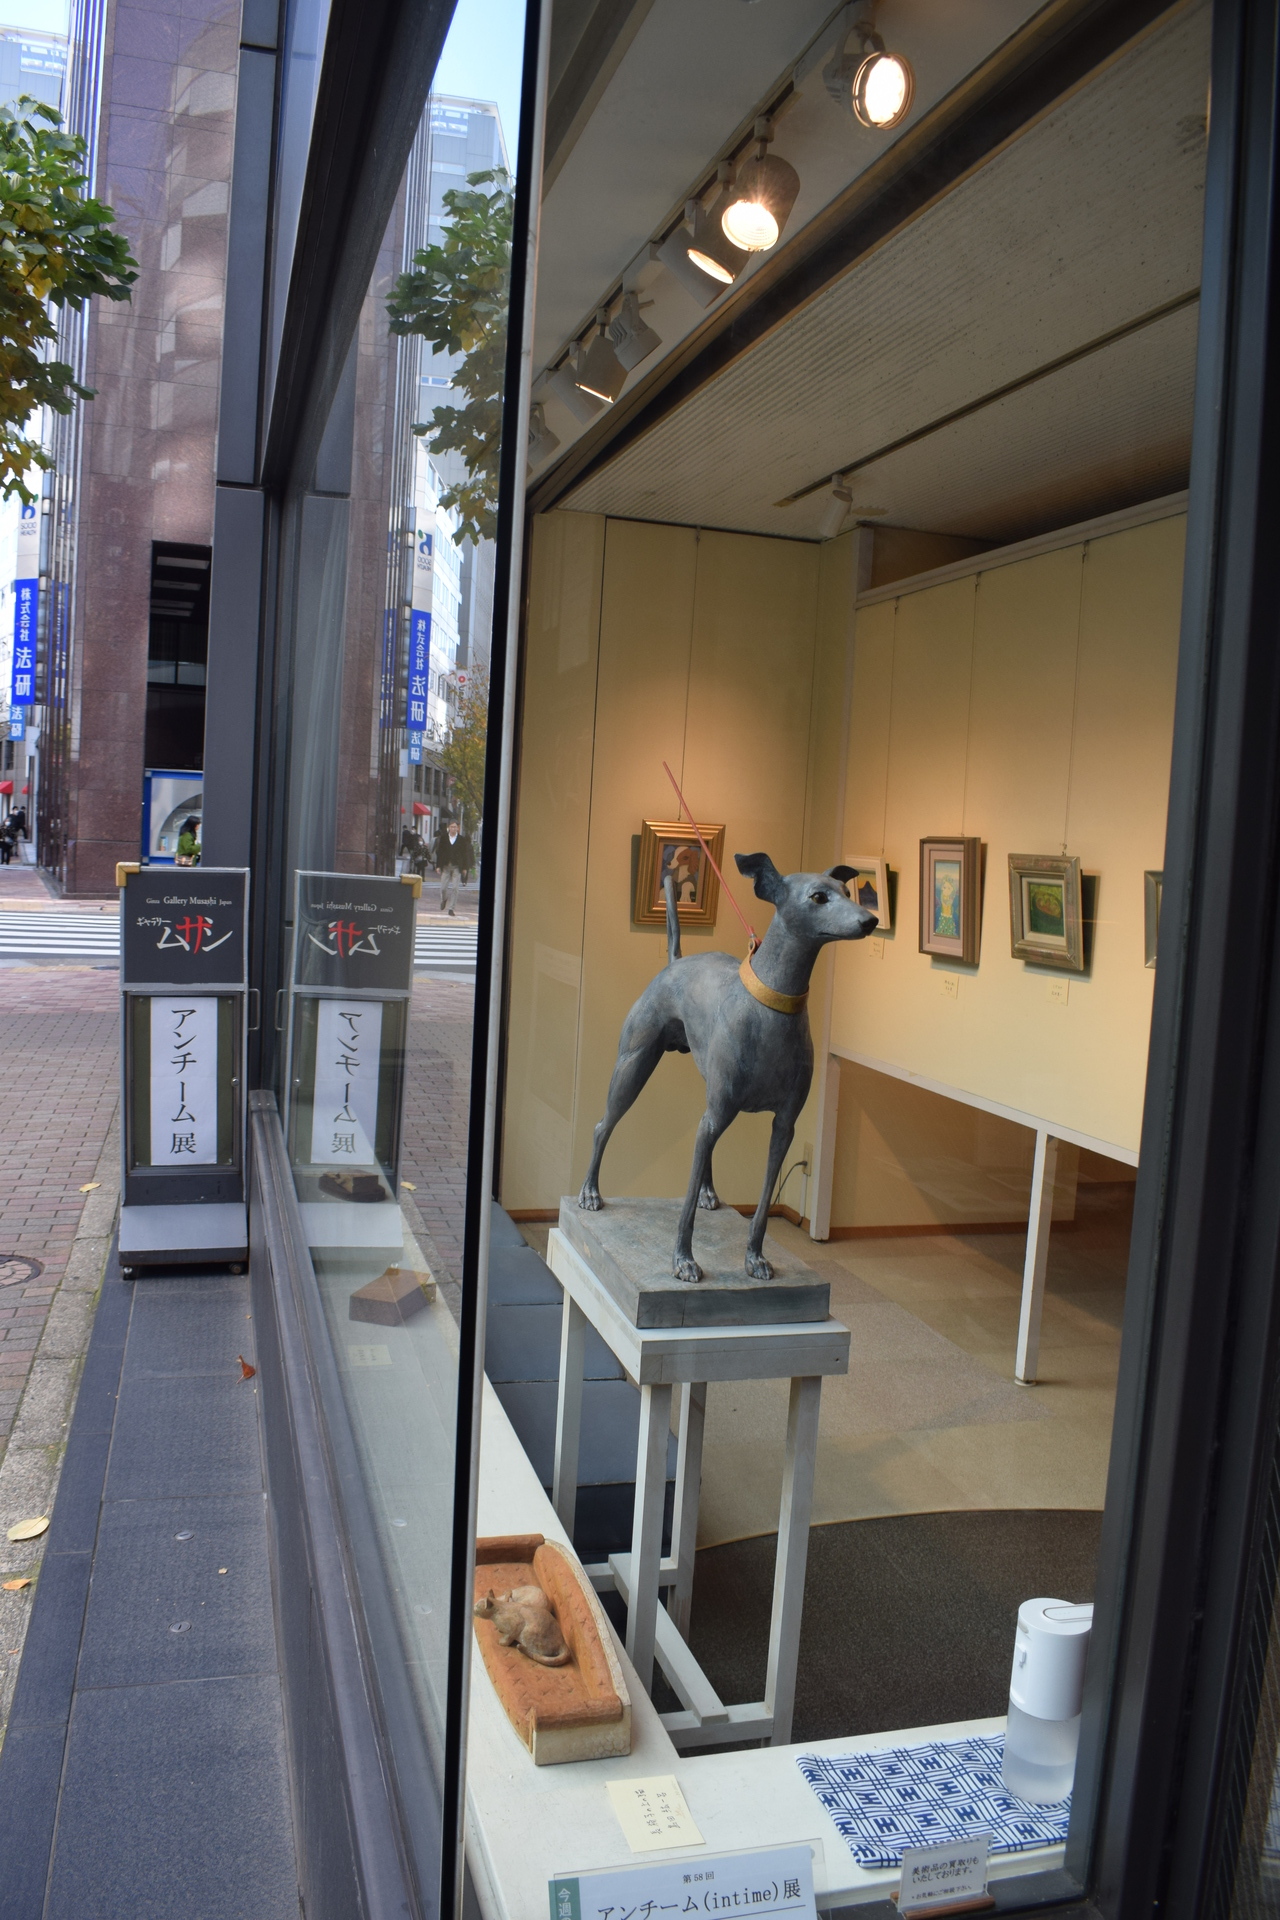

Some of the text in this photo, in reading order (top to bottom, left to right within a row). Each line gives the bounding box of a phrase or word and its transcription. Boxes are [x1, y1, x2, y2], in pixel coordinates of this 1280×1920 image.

[11, 706, 22, 737] 法研
[164, 896, 188, 906] Gallery
[190, 896, 216, 906] Musashi
[219, 898, 232, 906] Japan
[136, 916, 172, 927] ギャラリー
[170, 1008, 197, 1154] アンチーム展
[912, 1856, 980, 1876] 美術品の買取りも
[682, 1870, 715, 1884] 第58回
[912, 1867, 972, 1884] いたしております。
[597, 1878, 802, 1920] アンチーム(intime)展
